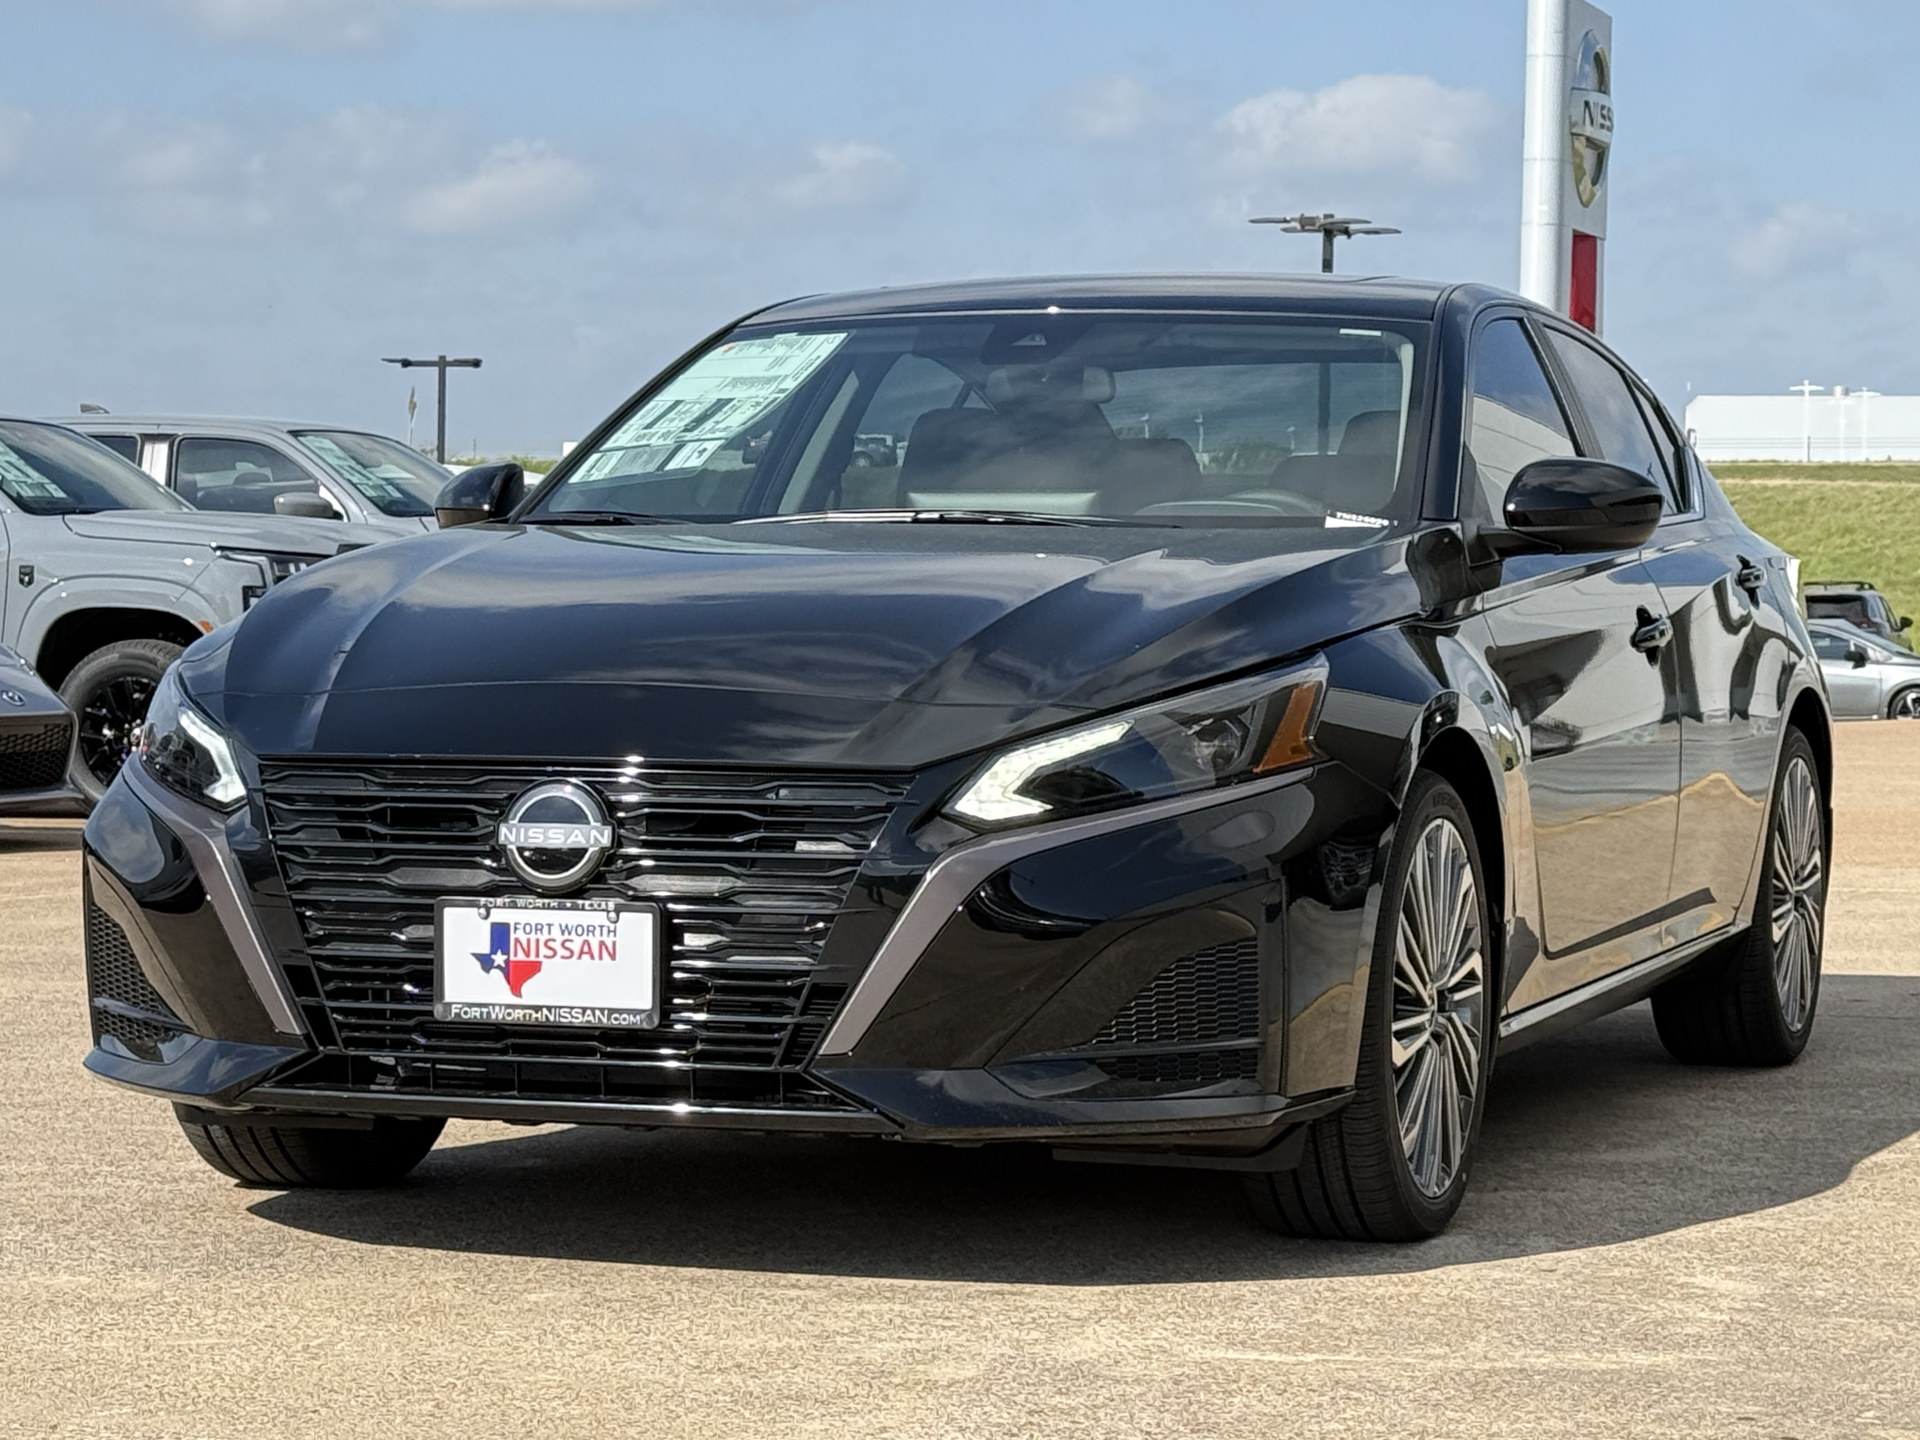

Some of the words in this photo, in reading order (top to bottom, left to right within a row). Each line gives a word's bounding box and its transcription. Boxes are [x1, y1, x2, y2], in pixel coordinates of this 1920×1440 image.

[500, 826, 609, 845] NISSAN
[480, 899, 510, 908] FORT
[516, 899, 559, 909] WORTH
[513, 922, 554, 936] FORT
[559, 923, 617, 938] WORTH
[513, 937, 617, 961] NISSAN
